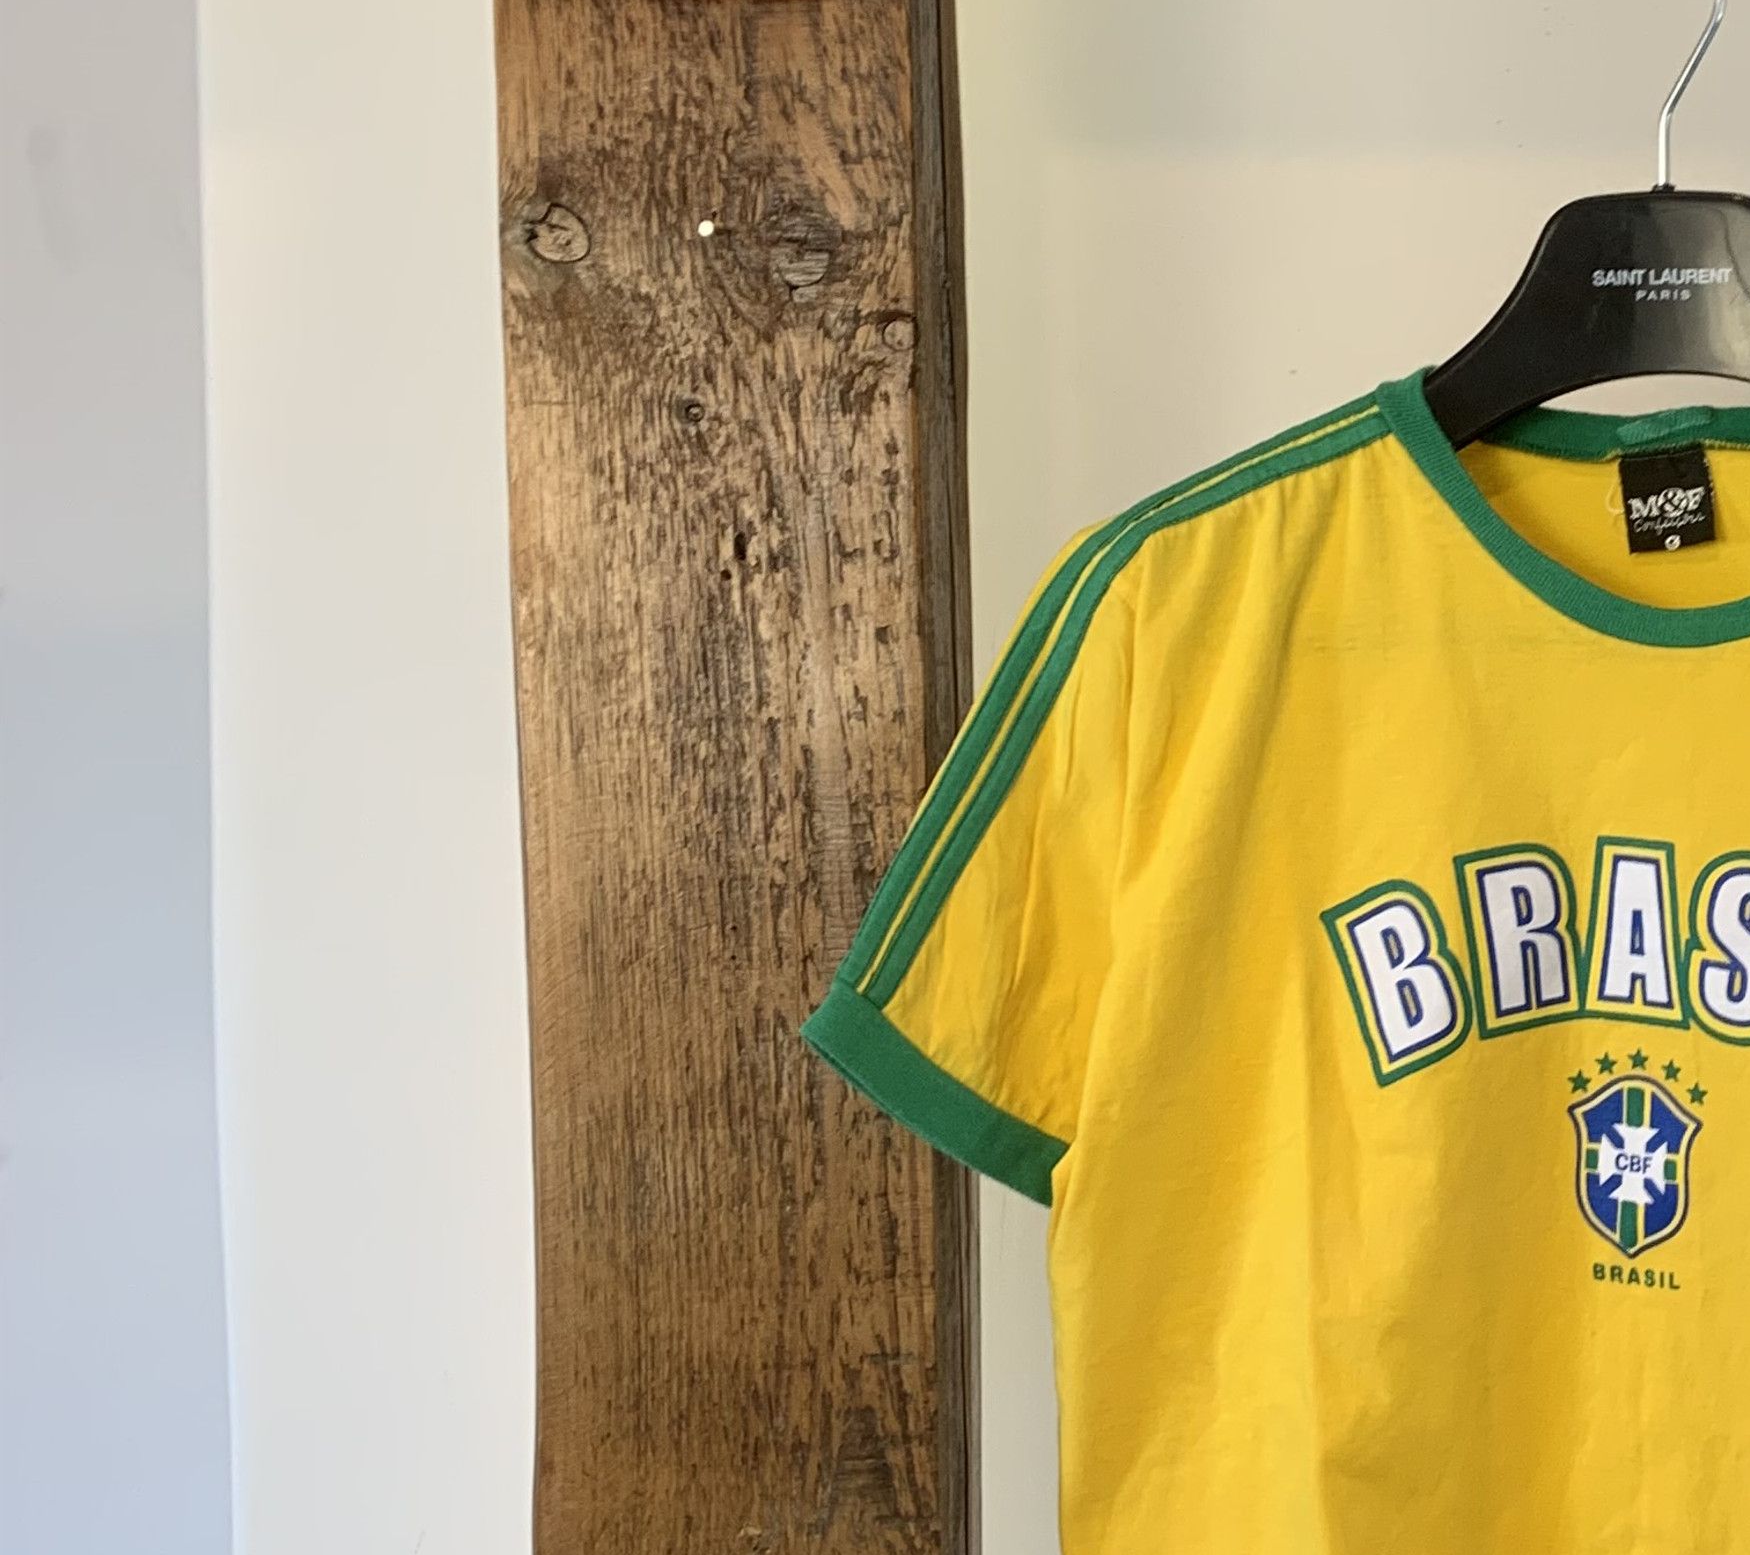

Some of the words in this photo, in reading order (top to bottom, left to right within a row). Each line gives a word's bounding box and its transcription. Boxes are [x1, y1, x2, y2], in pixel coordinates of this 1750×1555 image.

[1591, 267, 1647, 288] SAINT
[1649, 267, 1733, 286] LAURENT
[1635, 289, 1692, 302] PARIS
[1614, 1152, 1653, 1175] CBF
[1592, 1262, 1681, 1290] BRASIL
